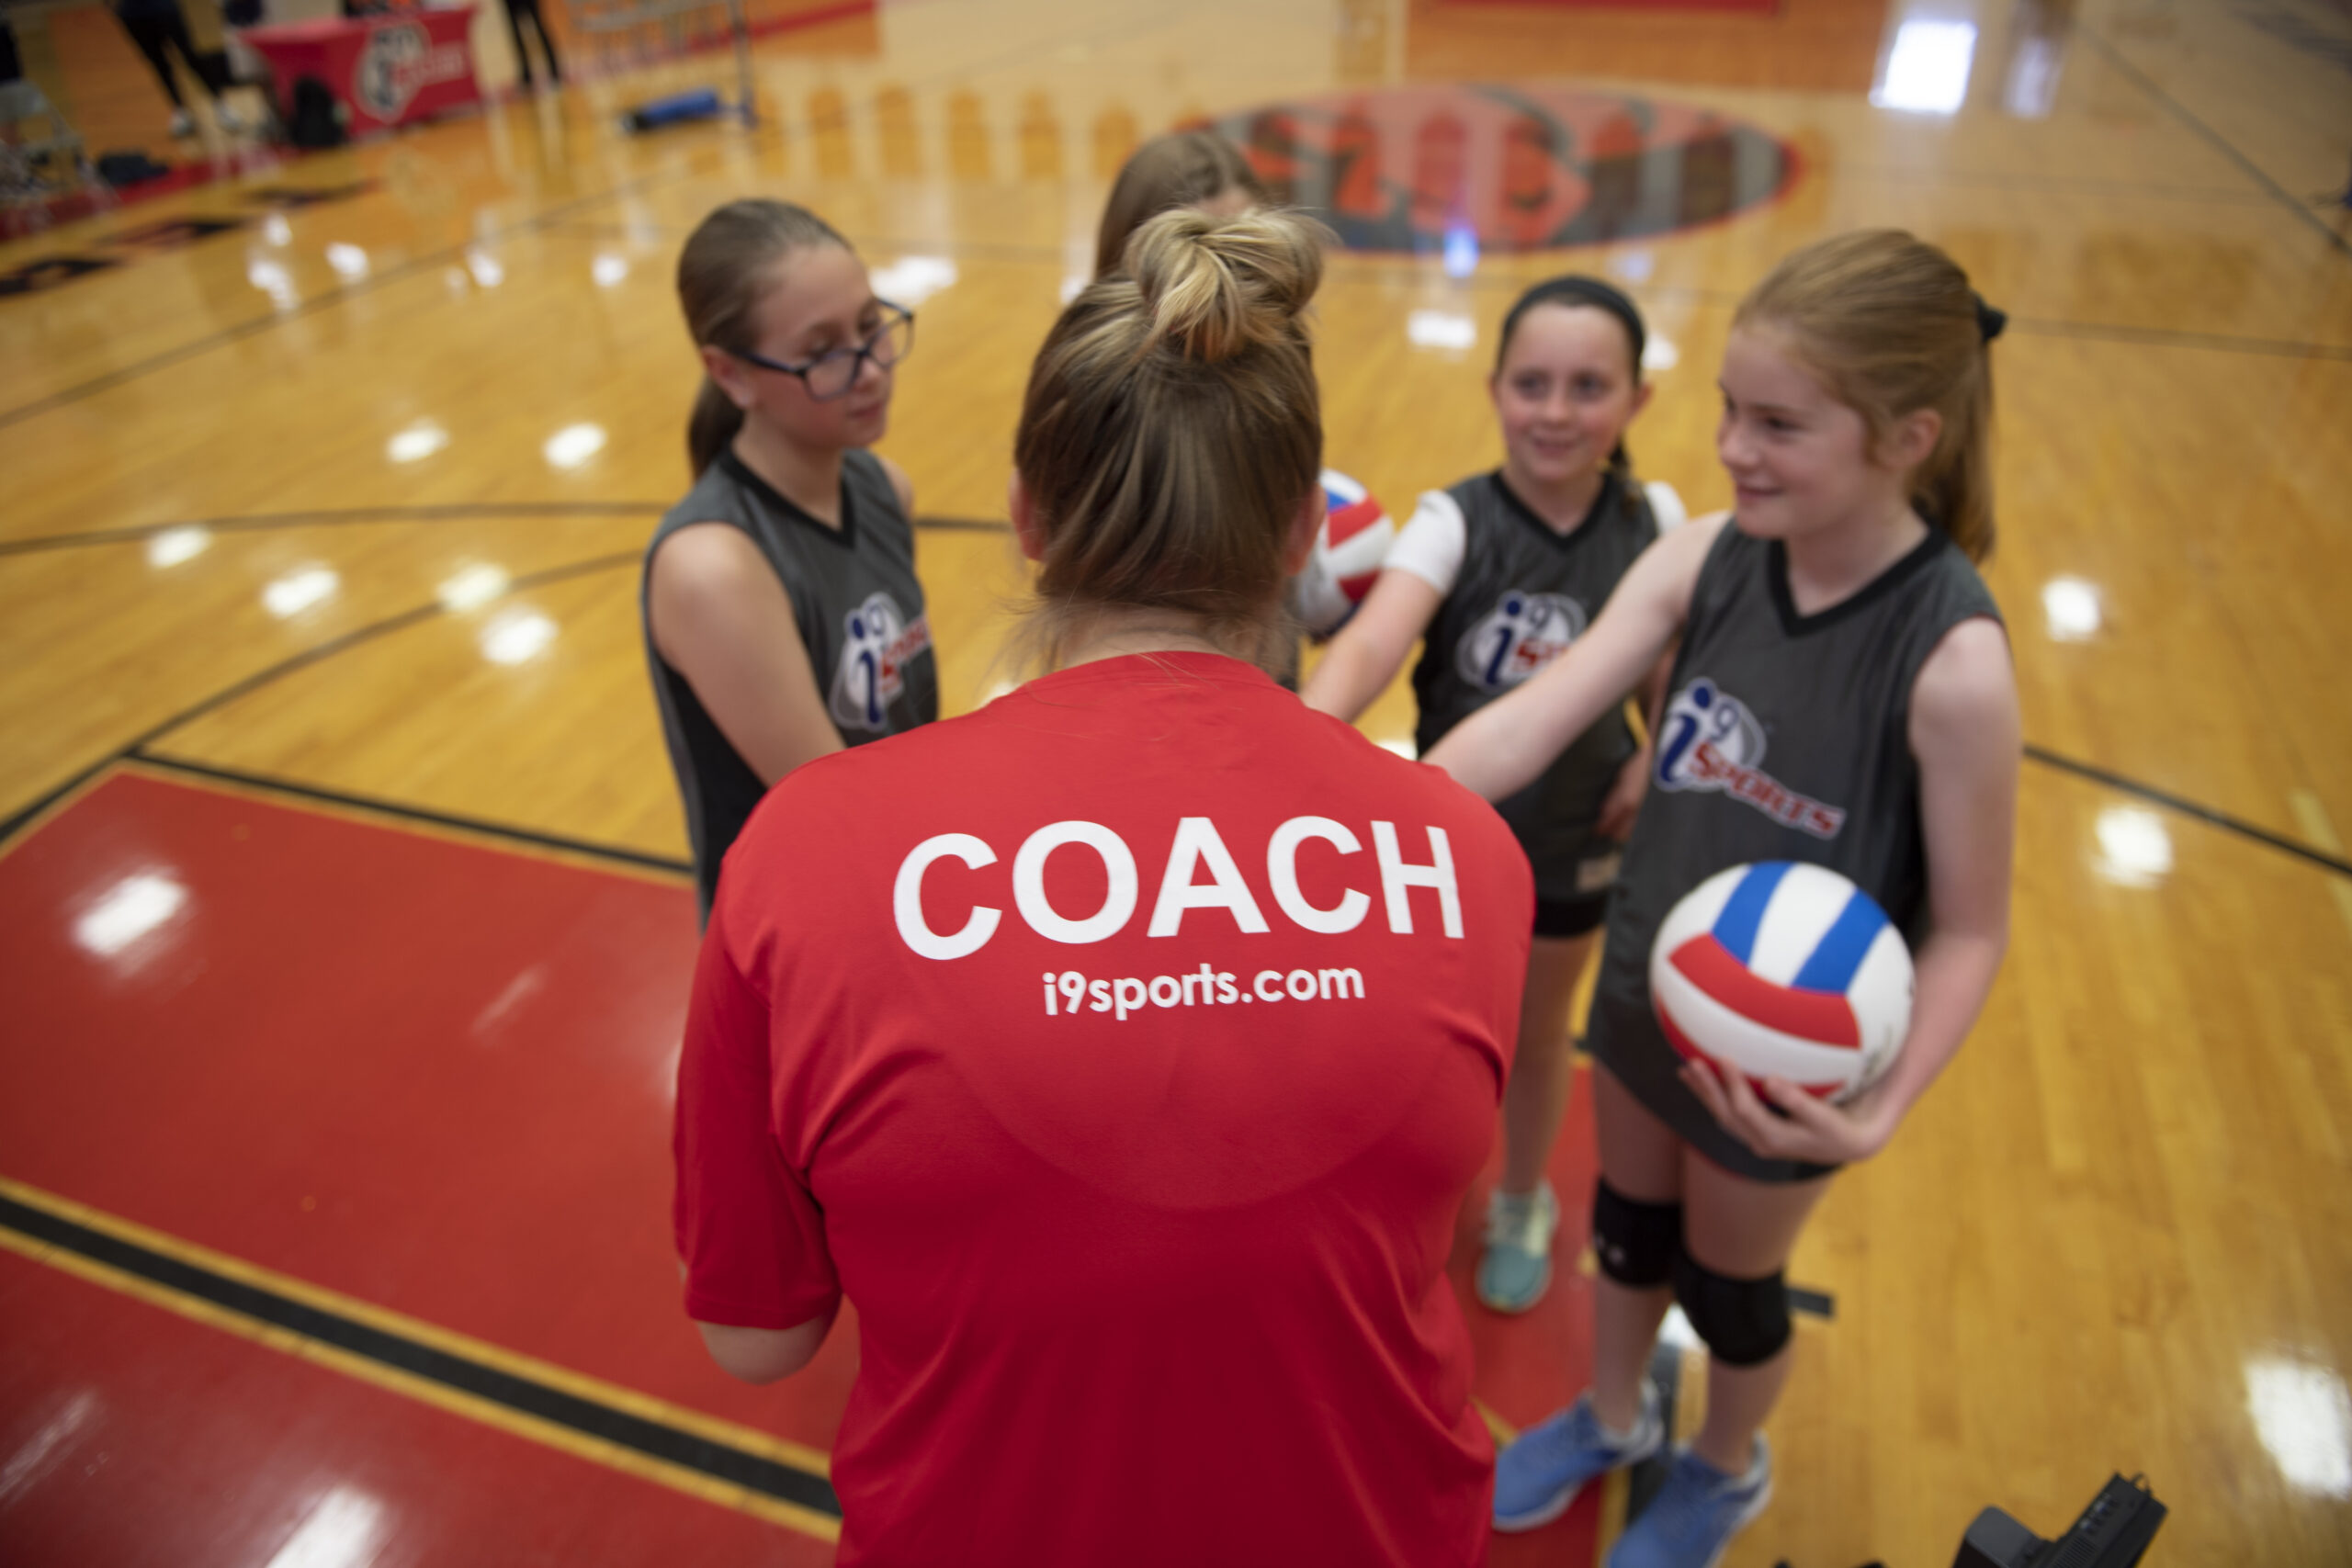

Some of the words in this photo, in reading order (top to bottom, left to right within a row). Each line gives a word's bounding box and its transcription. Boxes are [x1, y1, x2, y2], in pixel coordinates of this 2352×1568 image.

[1484, 597, 1555, 686] i9
[1658, 685, 1740, 783] i9
[893, 815, 1464, 961] COACH
[1043, 963, 1365, 1021] i9sports.com
